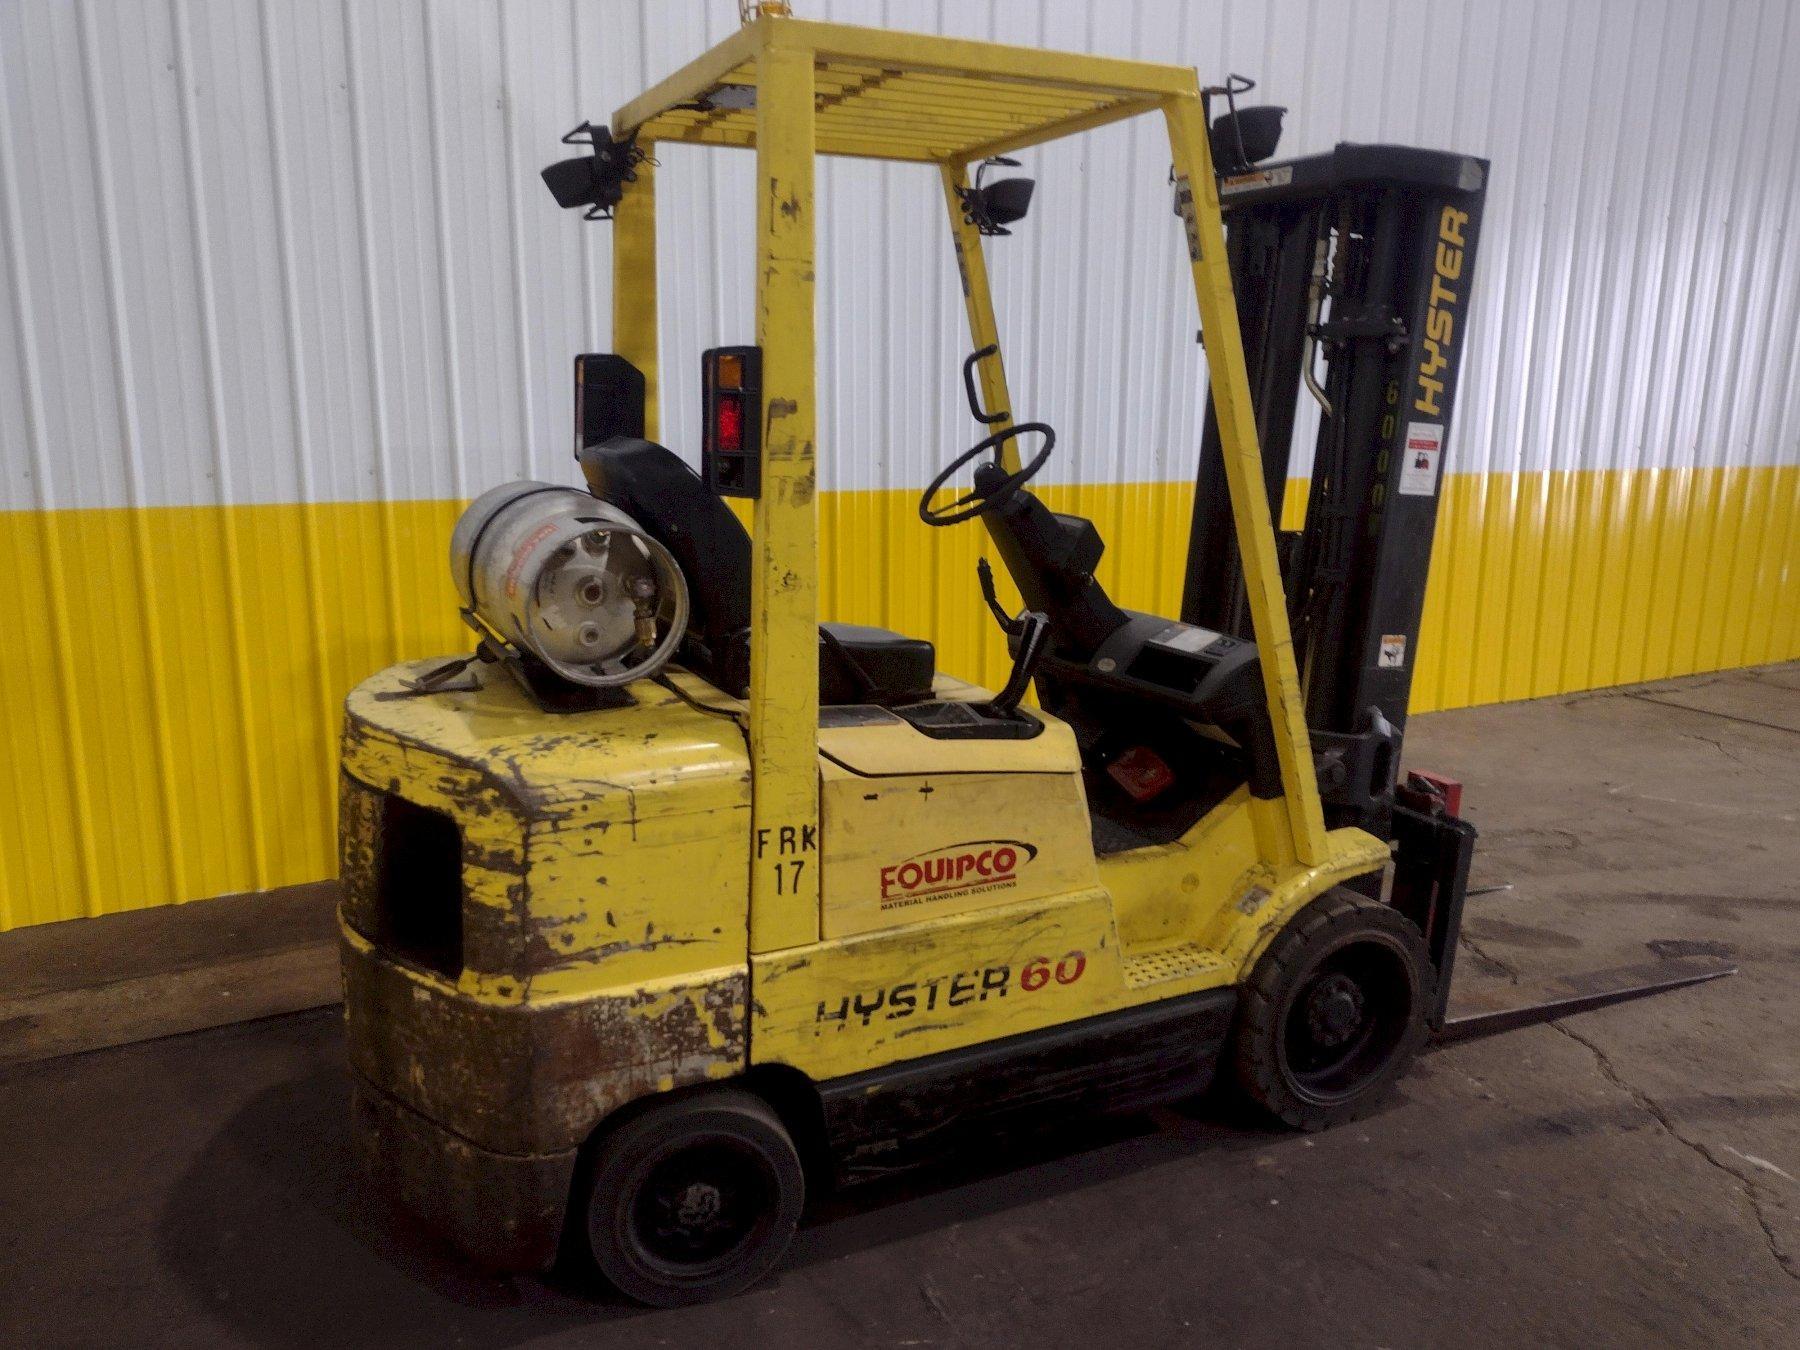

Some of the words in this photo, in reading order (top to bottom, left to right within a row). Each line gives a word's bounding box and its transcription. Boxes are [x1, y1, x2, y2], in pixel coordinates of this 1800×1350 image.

[1414, 205, 1469, 416] HYSTER
[757, 824, 817, 859] FRK
[774, 860, 805, 896] 17
[880, 898, 923, 911] MATERIAL
[925, 890, 969, 903] HANDLING
[971, 881, 1017, 895] SOLUTIONS
[815, 964, 1010, 1036] HYSTER
[1021, 950, 1087, 992] 60
